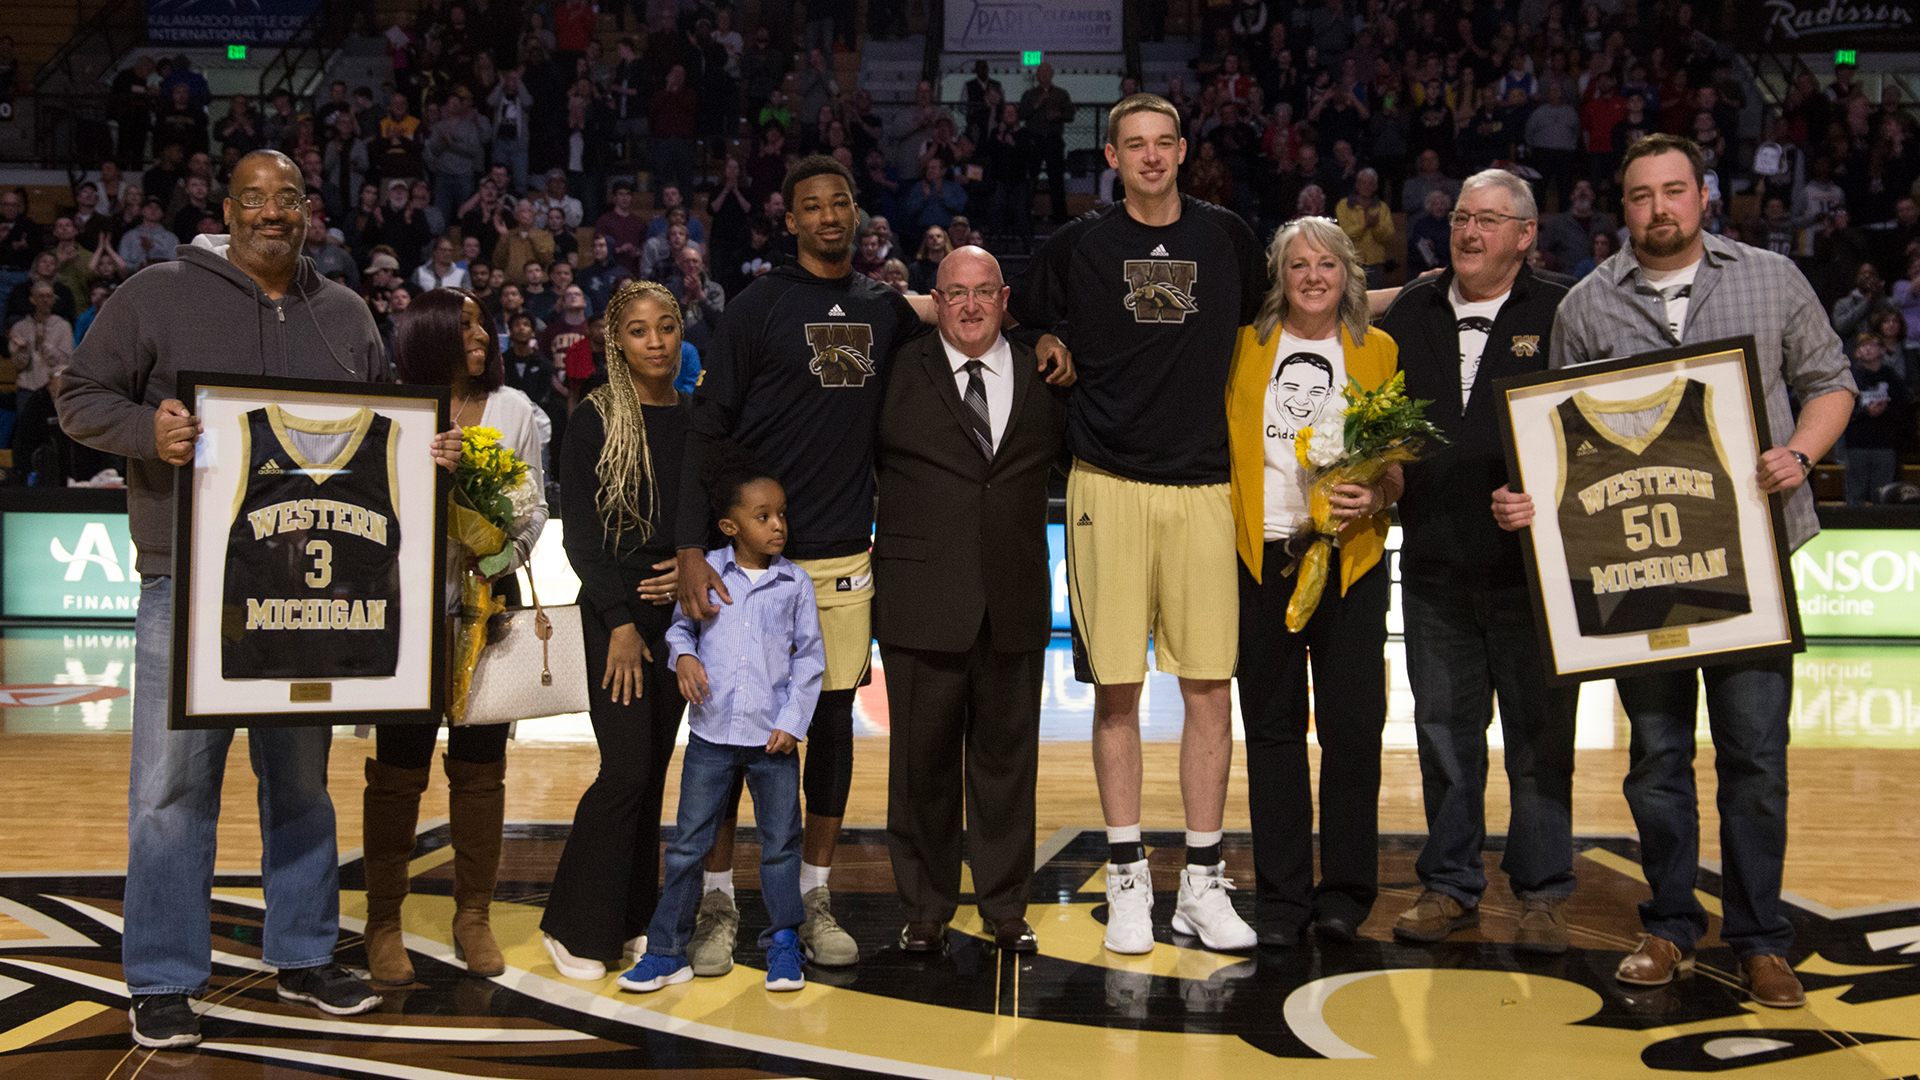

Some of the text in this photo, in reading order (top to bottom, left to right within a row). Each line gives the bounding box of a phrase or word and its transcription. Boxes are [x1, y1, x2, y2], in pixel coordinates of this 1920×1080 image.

[147, 14, 231, 27] KALAMAZOO
[232, 14, 276, 27] BATTLE
[148, 28, 258, 41] INTERNATIONAL
[1763, 0, 1912, 41] Radisson
[1578, 467, 1715, 515] WESTERN
[247, 498, 388, 546] WESTERN
[1622, 502, 1682, 552] 50
[304, 539, 333, 589] 3
[1590, 547, 1728, 594] MICHIGAN
[246, 598, 387, 631] MICHIGAN
